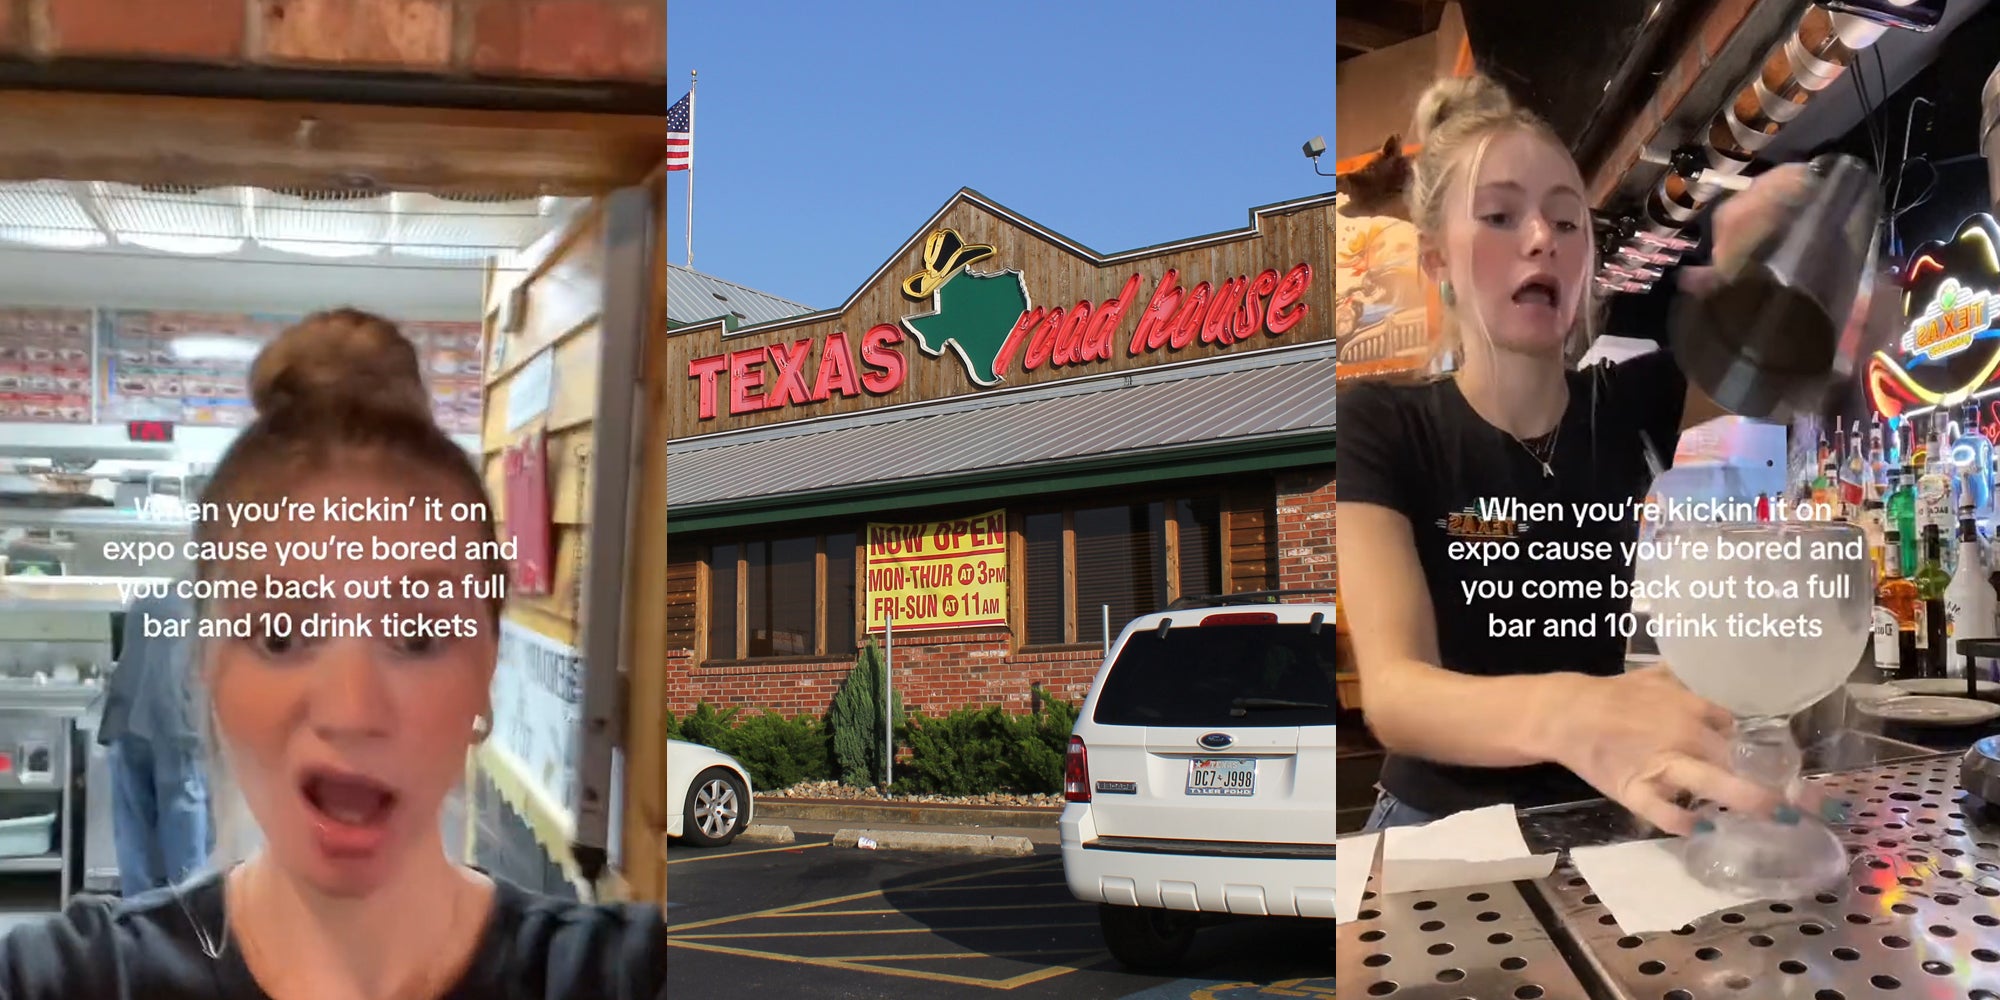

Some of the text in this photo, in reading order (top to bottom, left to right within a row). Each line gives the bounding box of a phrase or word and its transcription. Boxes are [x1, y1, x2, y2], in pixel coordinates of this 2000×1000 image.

[689, 262, 1313, 419] TEXAS road house
[870, 514, 1004, 556] NOW OPEN
[868, 563, 953, 592] MON-THUR
[959, 567, 973, 582] AT
[874, 594, 938, 621] FRI-SUN
[944, 598, 957, 614] AT
[1209, 760, 1239, 769] TEXAS
